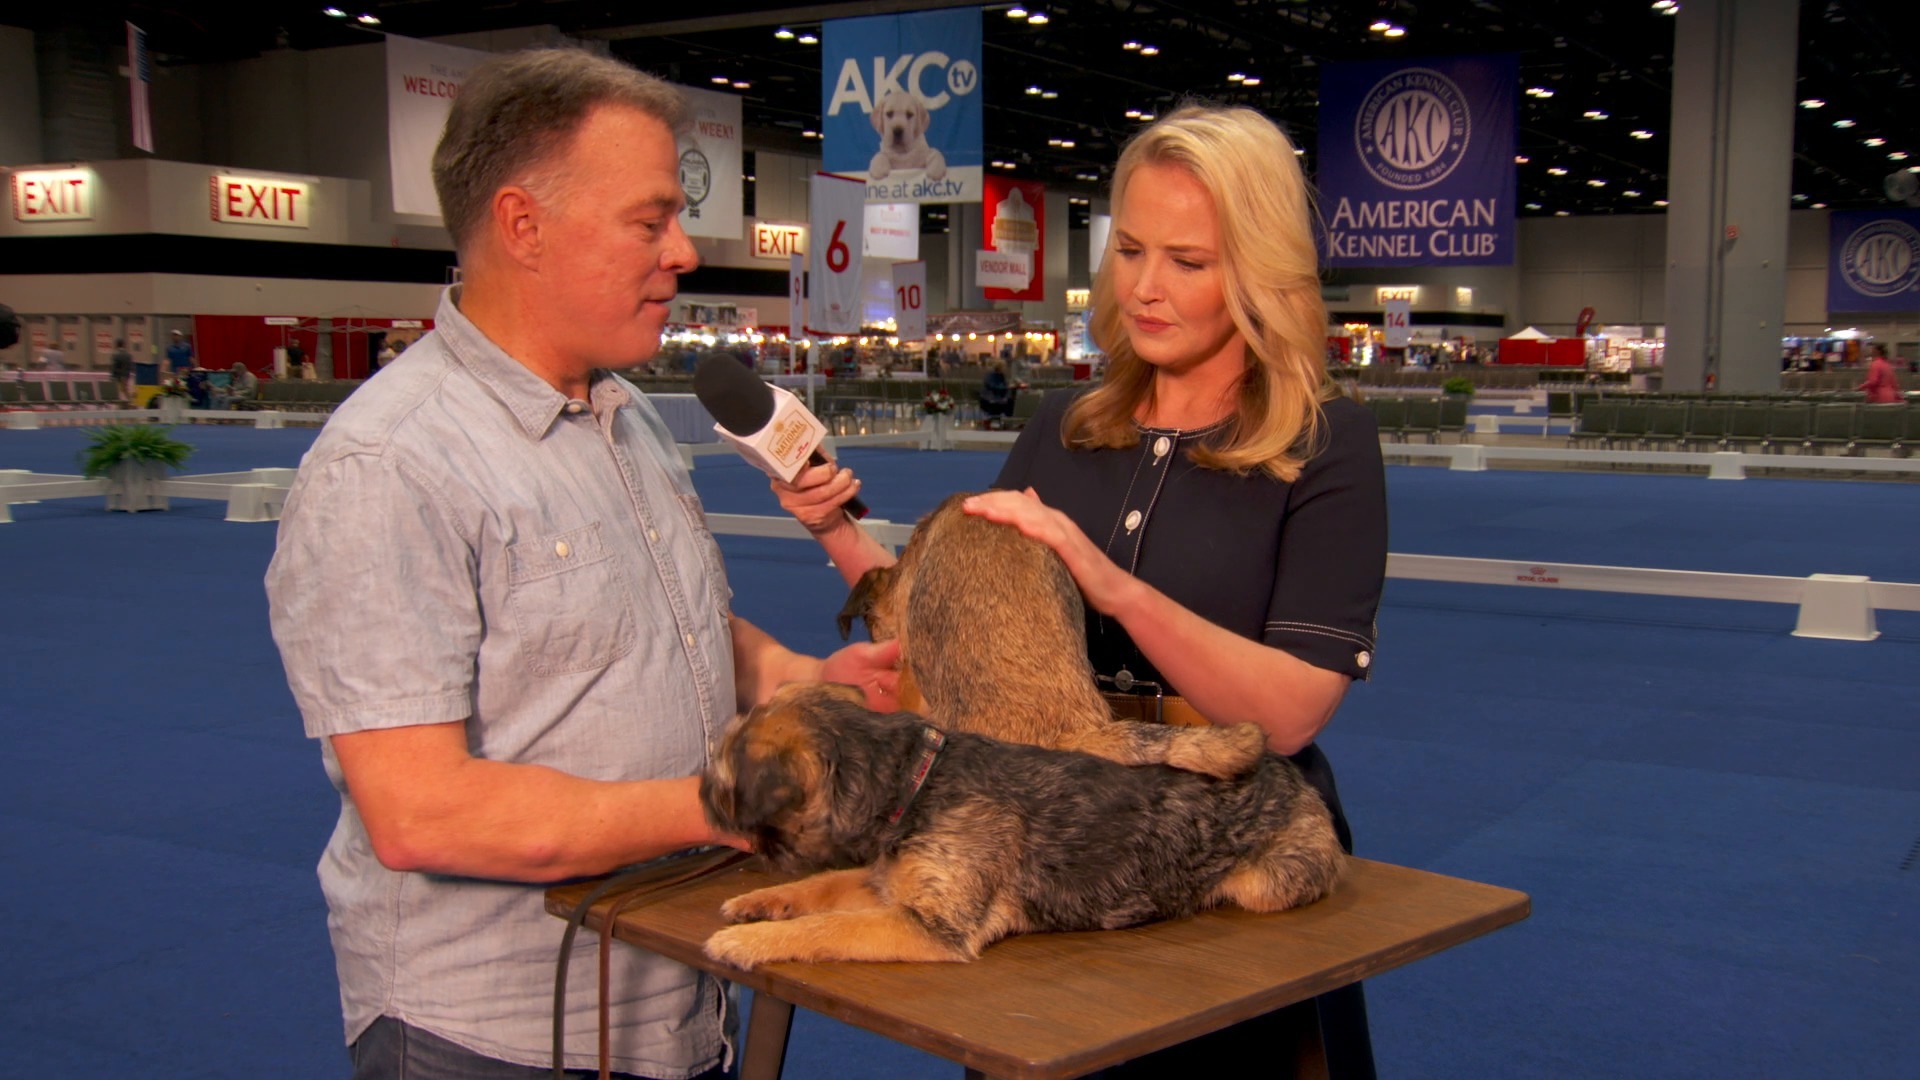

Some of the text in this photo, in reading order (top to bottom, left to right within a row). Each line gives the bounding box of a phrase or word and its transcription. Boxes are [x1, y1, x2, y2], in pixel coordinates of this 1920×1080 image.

[403, 74, 463, 99] WELCO
[827, 51, 973, 116] AKC tv
[1362, 75, 1464, 139] AMERICAN KENNEL CLUB
[1380, 95, 1445, 165] AKC
[1376, 162, 1422, 183] FOUNDED
[25, 179, 83, 215] EXIT
[226, 183, 301, 221] EXIT
[892, 181, 908, 198] at
[912, 179, 963, 197] akc.tv
[1331, 197, 1497, 229] AMERICAN
[758, 229, 799, 255] EXIT
[826, 220, 850, 274] 6
[1328, 231, 1423, 258] KENNEL
[980, 260, 1027, 276] VENDOR MALL
[897, 284, 921, 311] 10
[1386, 312, 1405, 329] 14
[775, 421, 805, 458] NATIONAL
